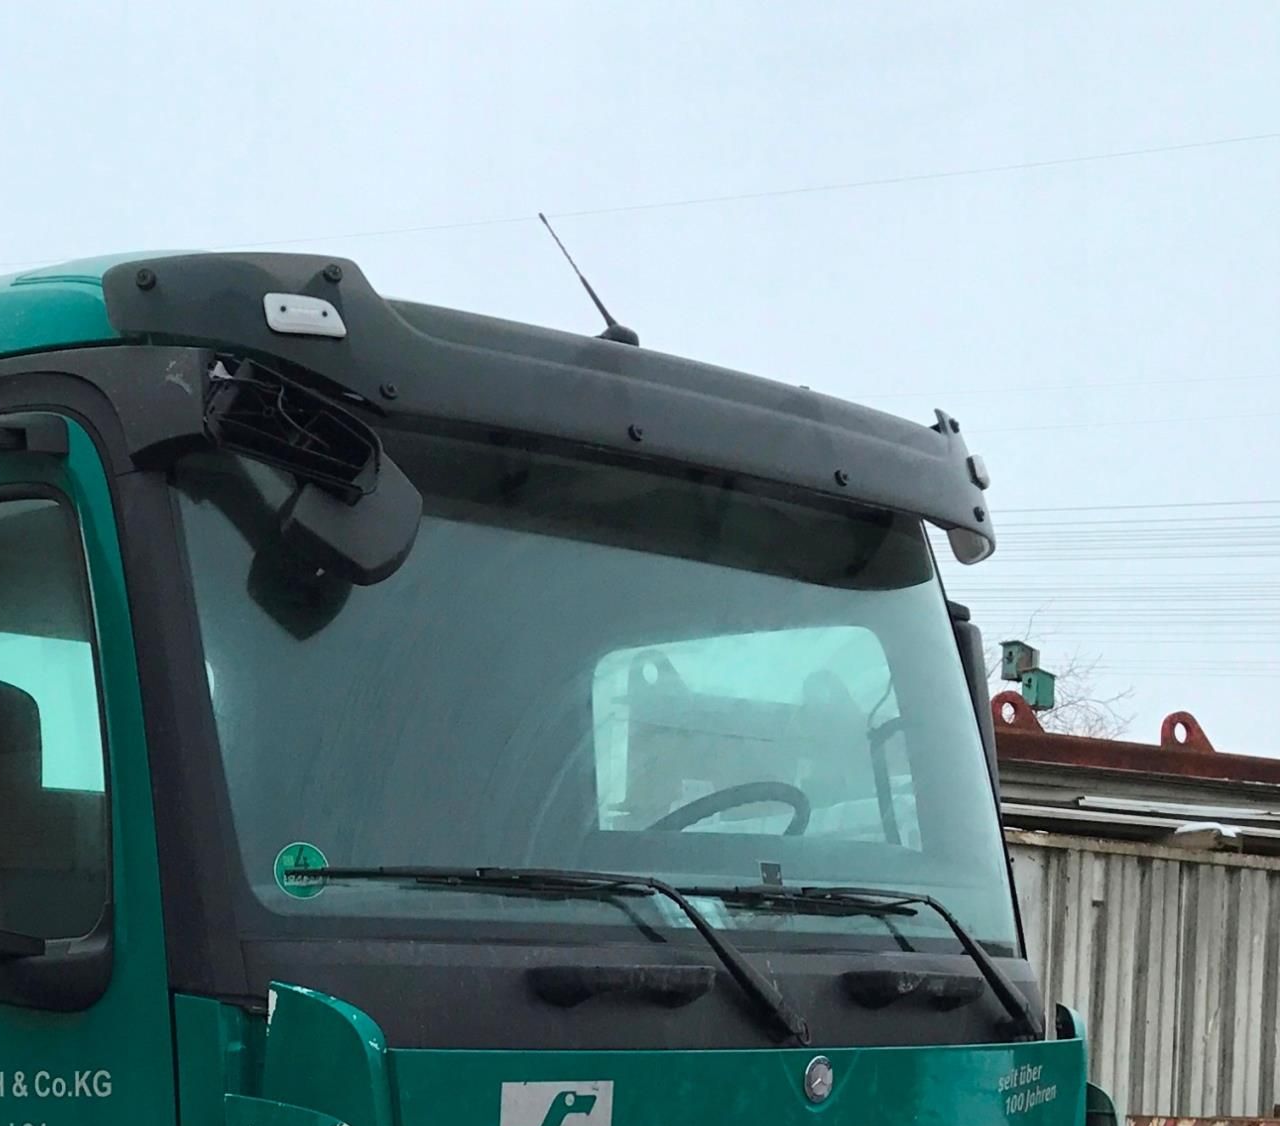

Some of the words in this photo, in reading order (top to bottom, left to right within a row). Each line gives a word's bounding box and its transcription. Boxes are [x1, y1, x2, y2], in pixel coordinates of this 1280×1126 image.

[12, 1070, 29, 1098] &
[34, 1069, 112, 1098] Co.KG
[997, 1067, 1018, 1093] seit
[1019, 1064, 1044, 1088] über
[1005, 1094, 1025, 1116] 100
[1024, 1083, 1057, 1113] Jahren
